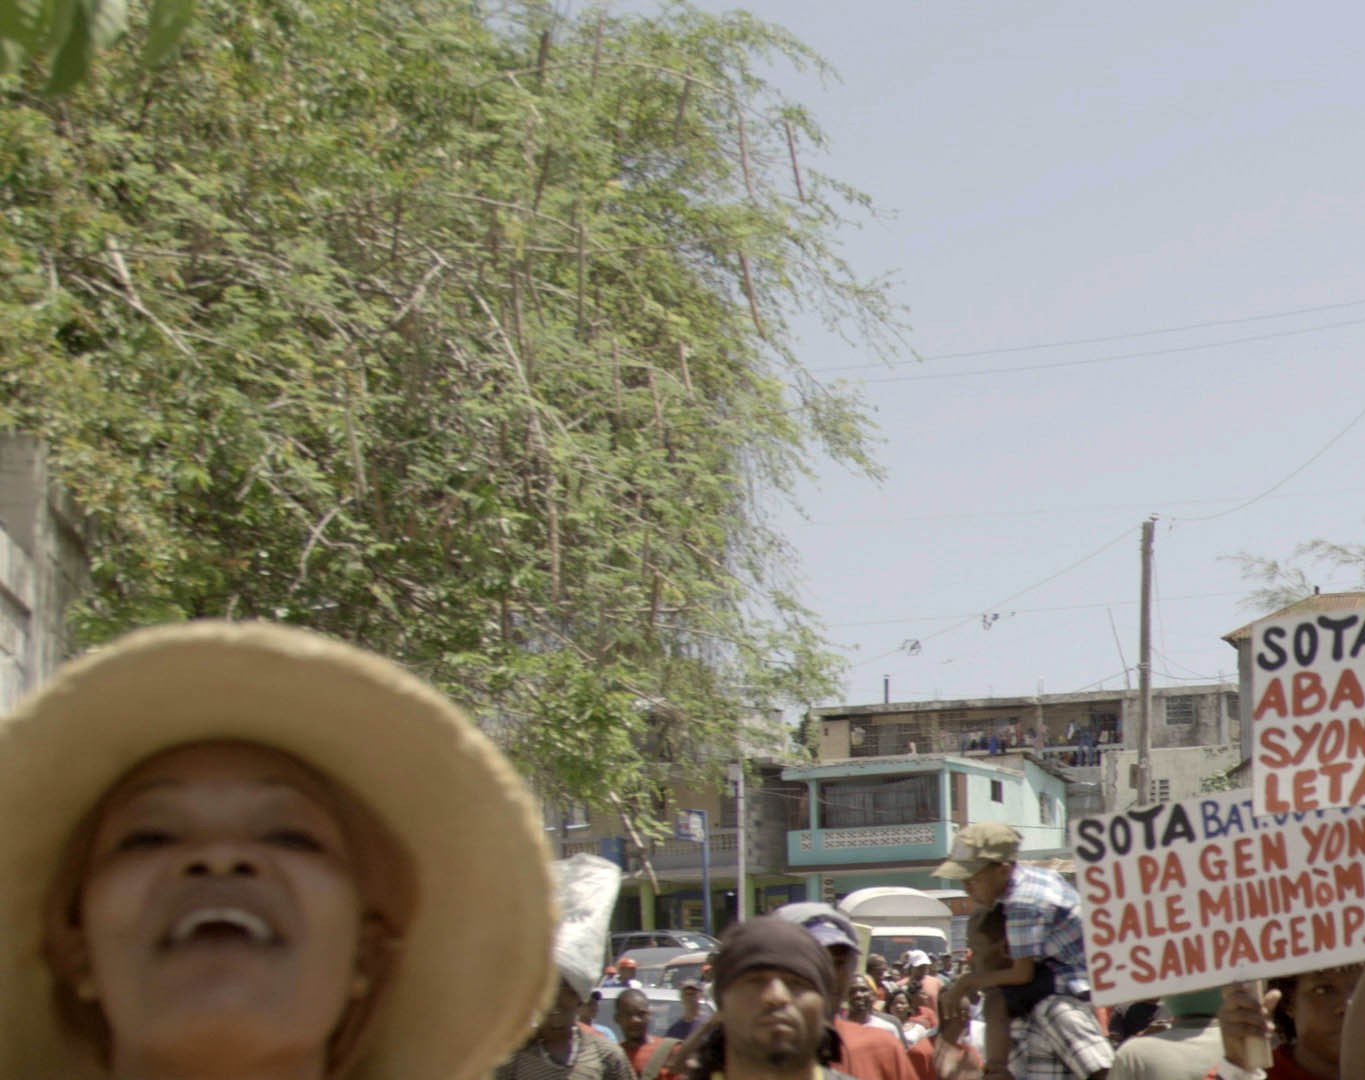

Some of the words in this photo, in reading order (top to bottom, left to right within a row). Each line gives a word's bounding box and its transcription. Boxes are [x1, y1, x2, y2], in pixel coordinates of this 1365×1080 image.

[1252, 667, 1365, 721] ABA
[1075, 803, 1196, 864] SOTA
[1084, 860, 1125, 905] SI
[1137, 850, 1187, 895] PA
[1199, 829, 1289, 883] GEN
[1090, 893, 1192, 948] SALE
